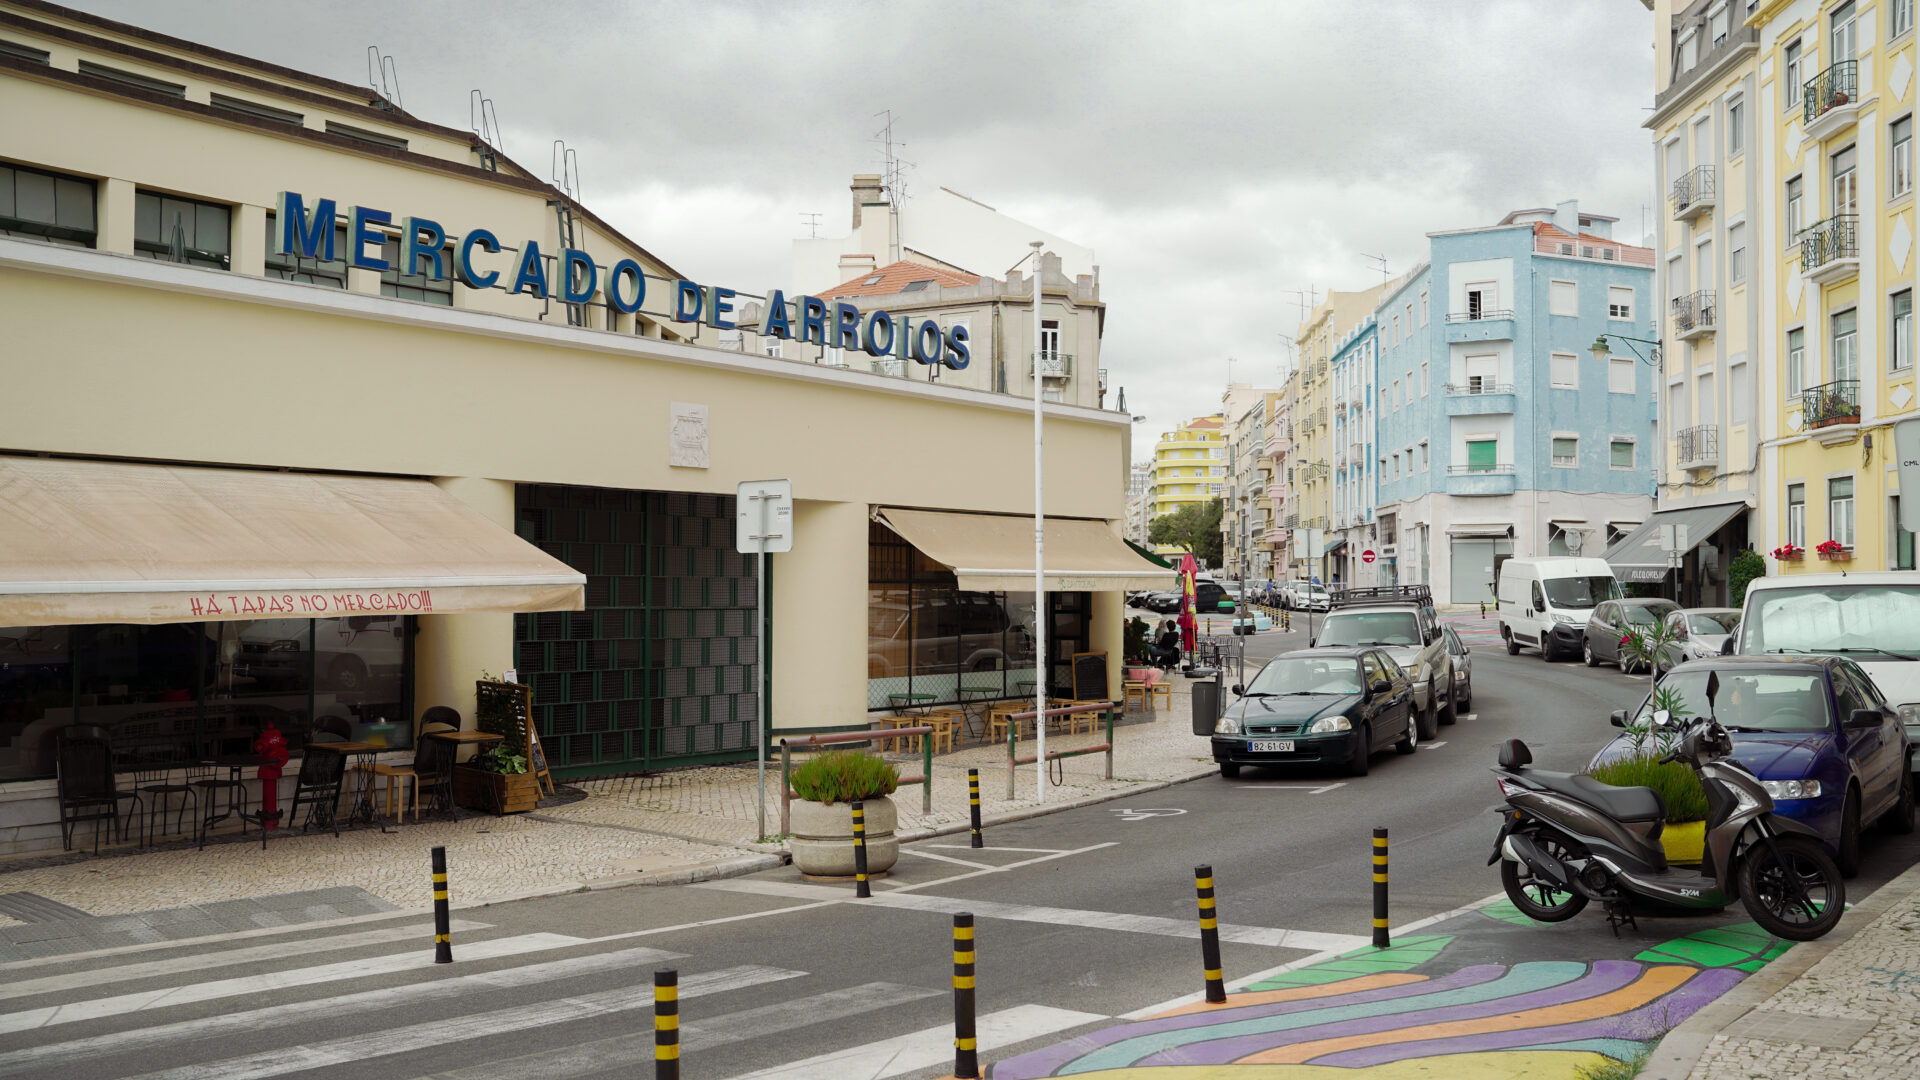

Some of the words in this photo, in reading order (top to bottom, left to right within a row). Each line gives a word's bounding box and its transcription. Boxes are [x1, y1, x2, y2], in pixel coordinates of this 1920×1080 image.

[276, 191, 647, 314] MERCADO
[671, 279, 736, 330] DE
[758, 289, 970, 371] ARROIOS
[191, 594, 223, 616] HÁ
[228, 595, 294, 614] TAPAS
[300, 594, 328, 612] NO
[333, 590, 433, 613] MERCADO!!!
[1680, 888, 1700, 897] SYM
